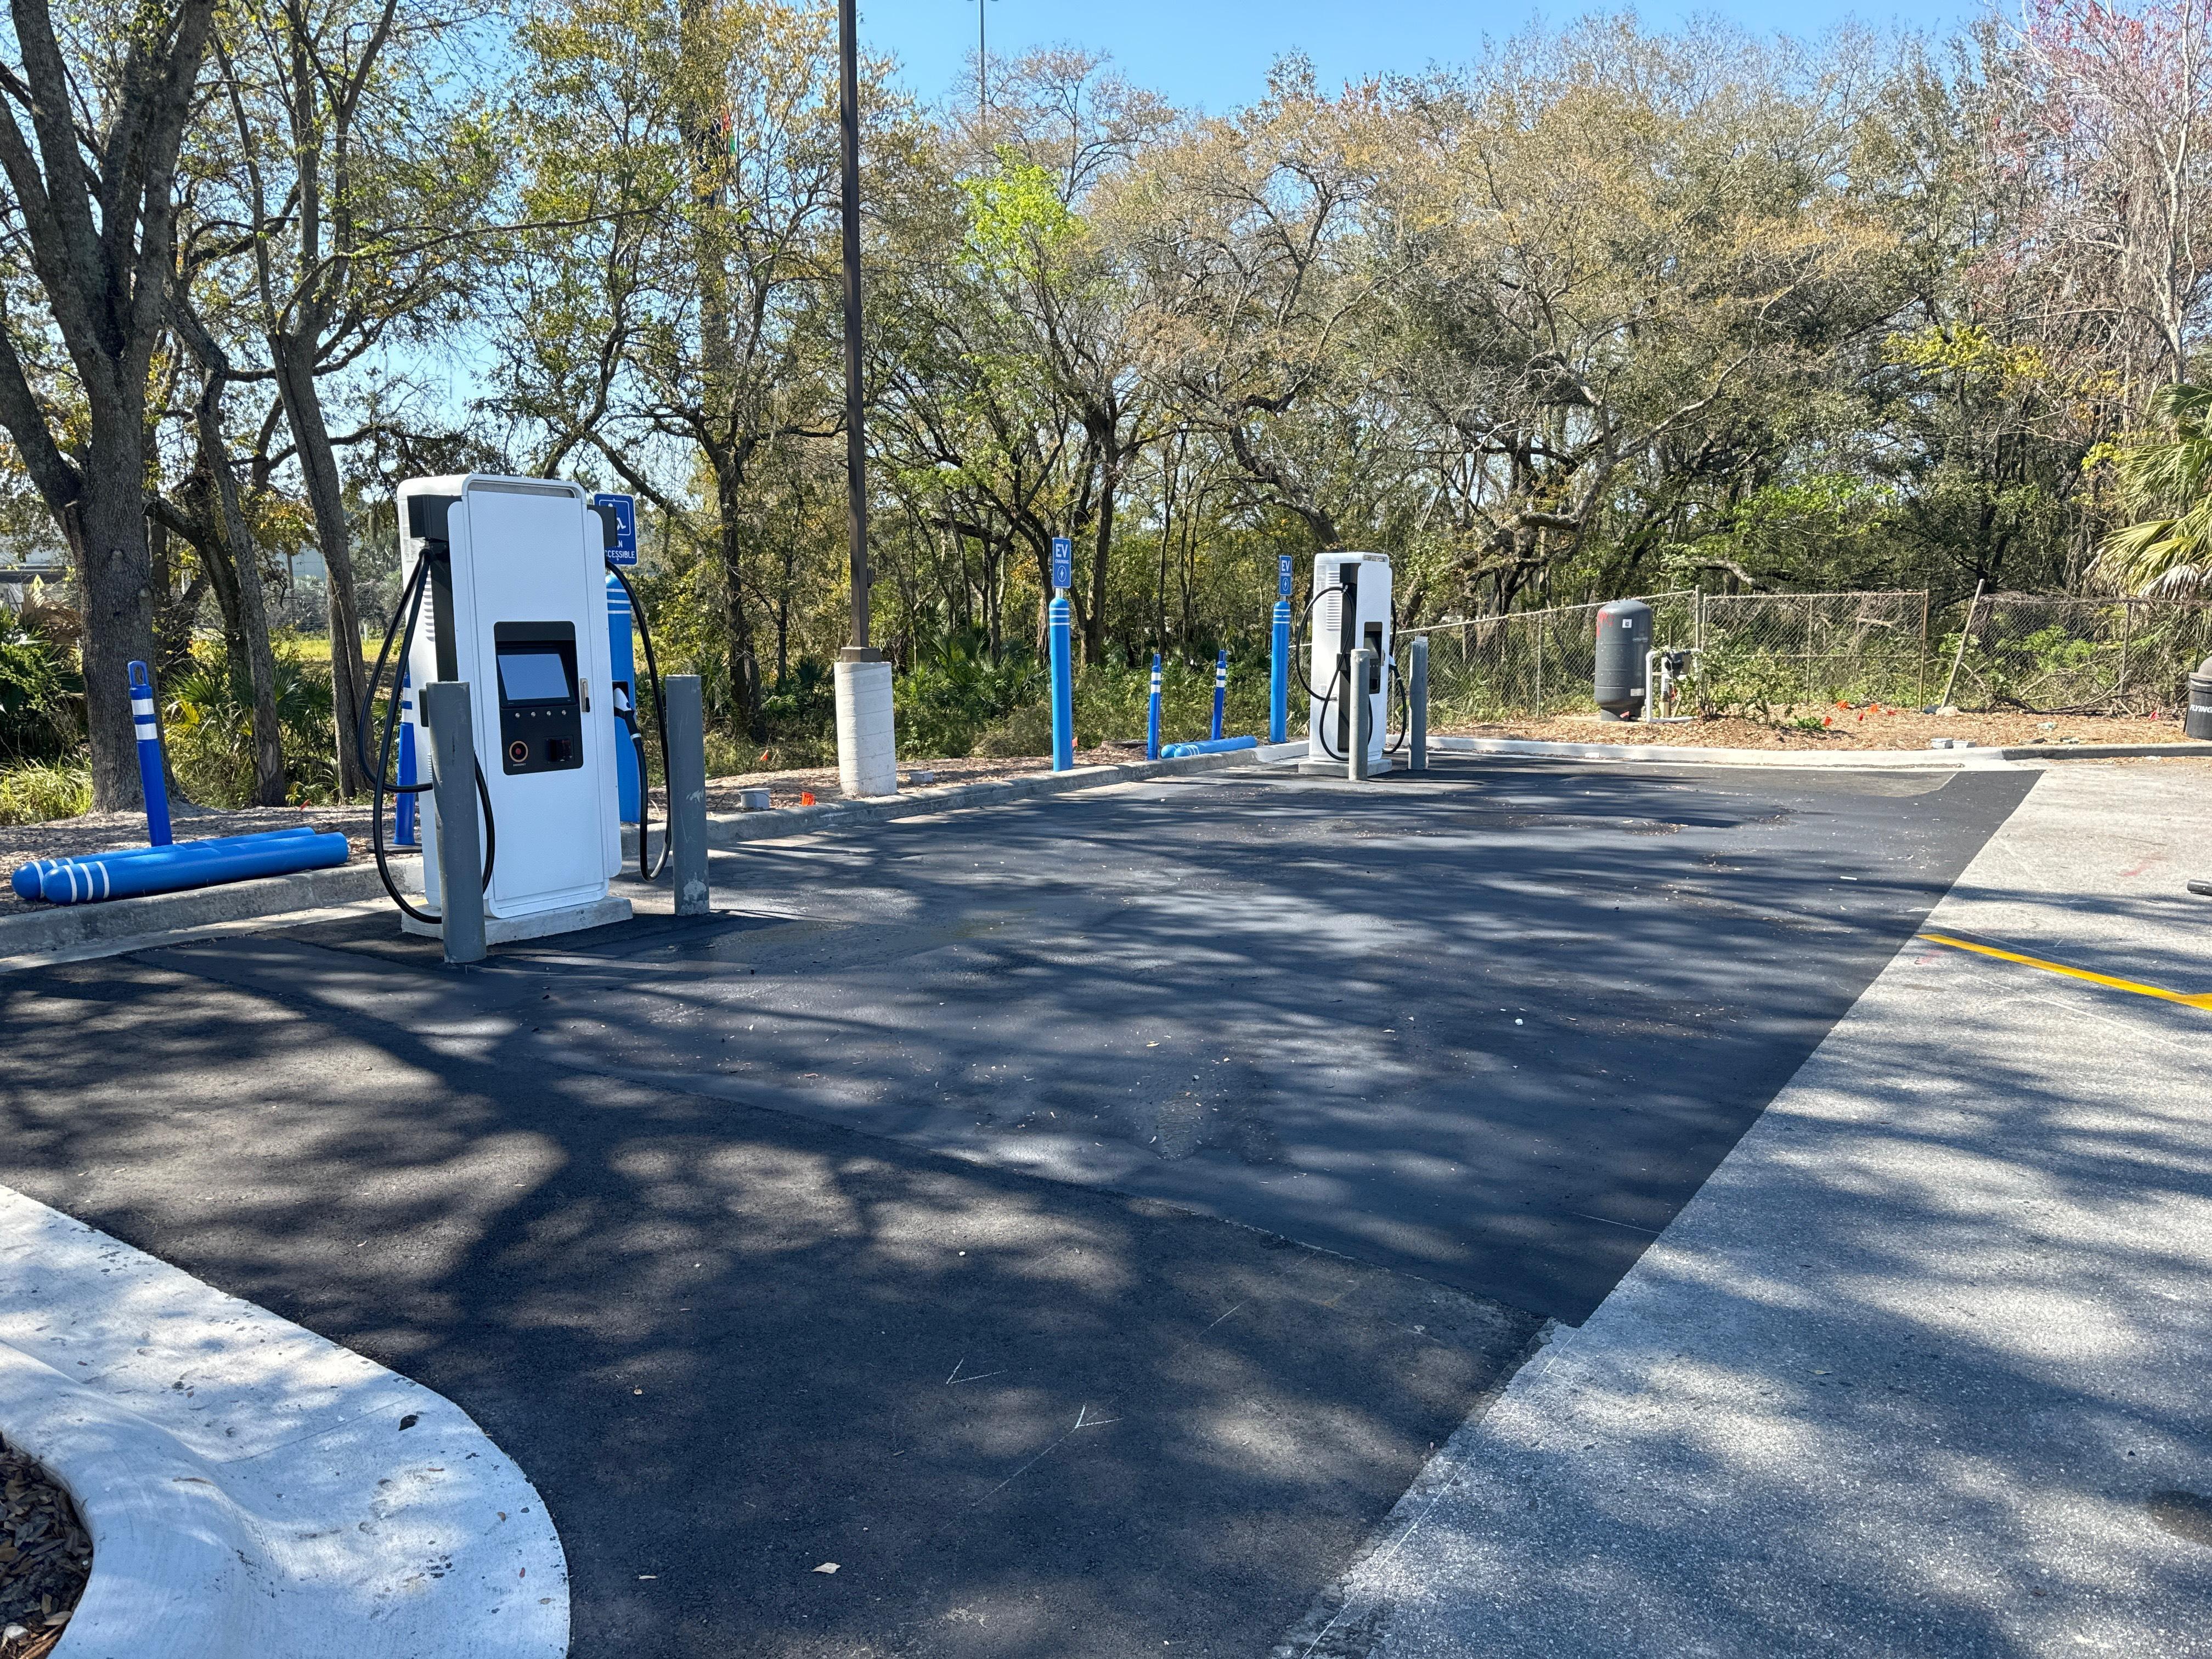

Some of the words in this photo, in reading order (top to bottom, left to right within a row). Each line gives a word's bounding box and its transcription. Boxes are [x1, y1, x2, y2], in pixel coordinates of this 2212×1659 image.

[605, 550, 635, 558] CCESSIBLE
[1056, 544, 1068, 557] EV
[1282, 560, 1290, 571] EV
[2190, 704, 2212, 713] FLYING
